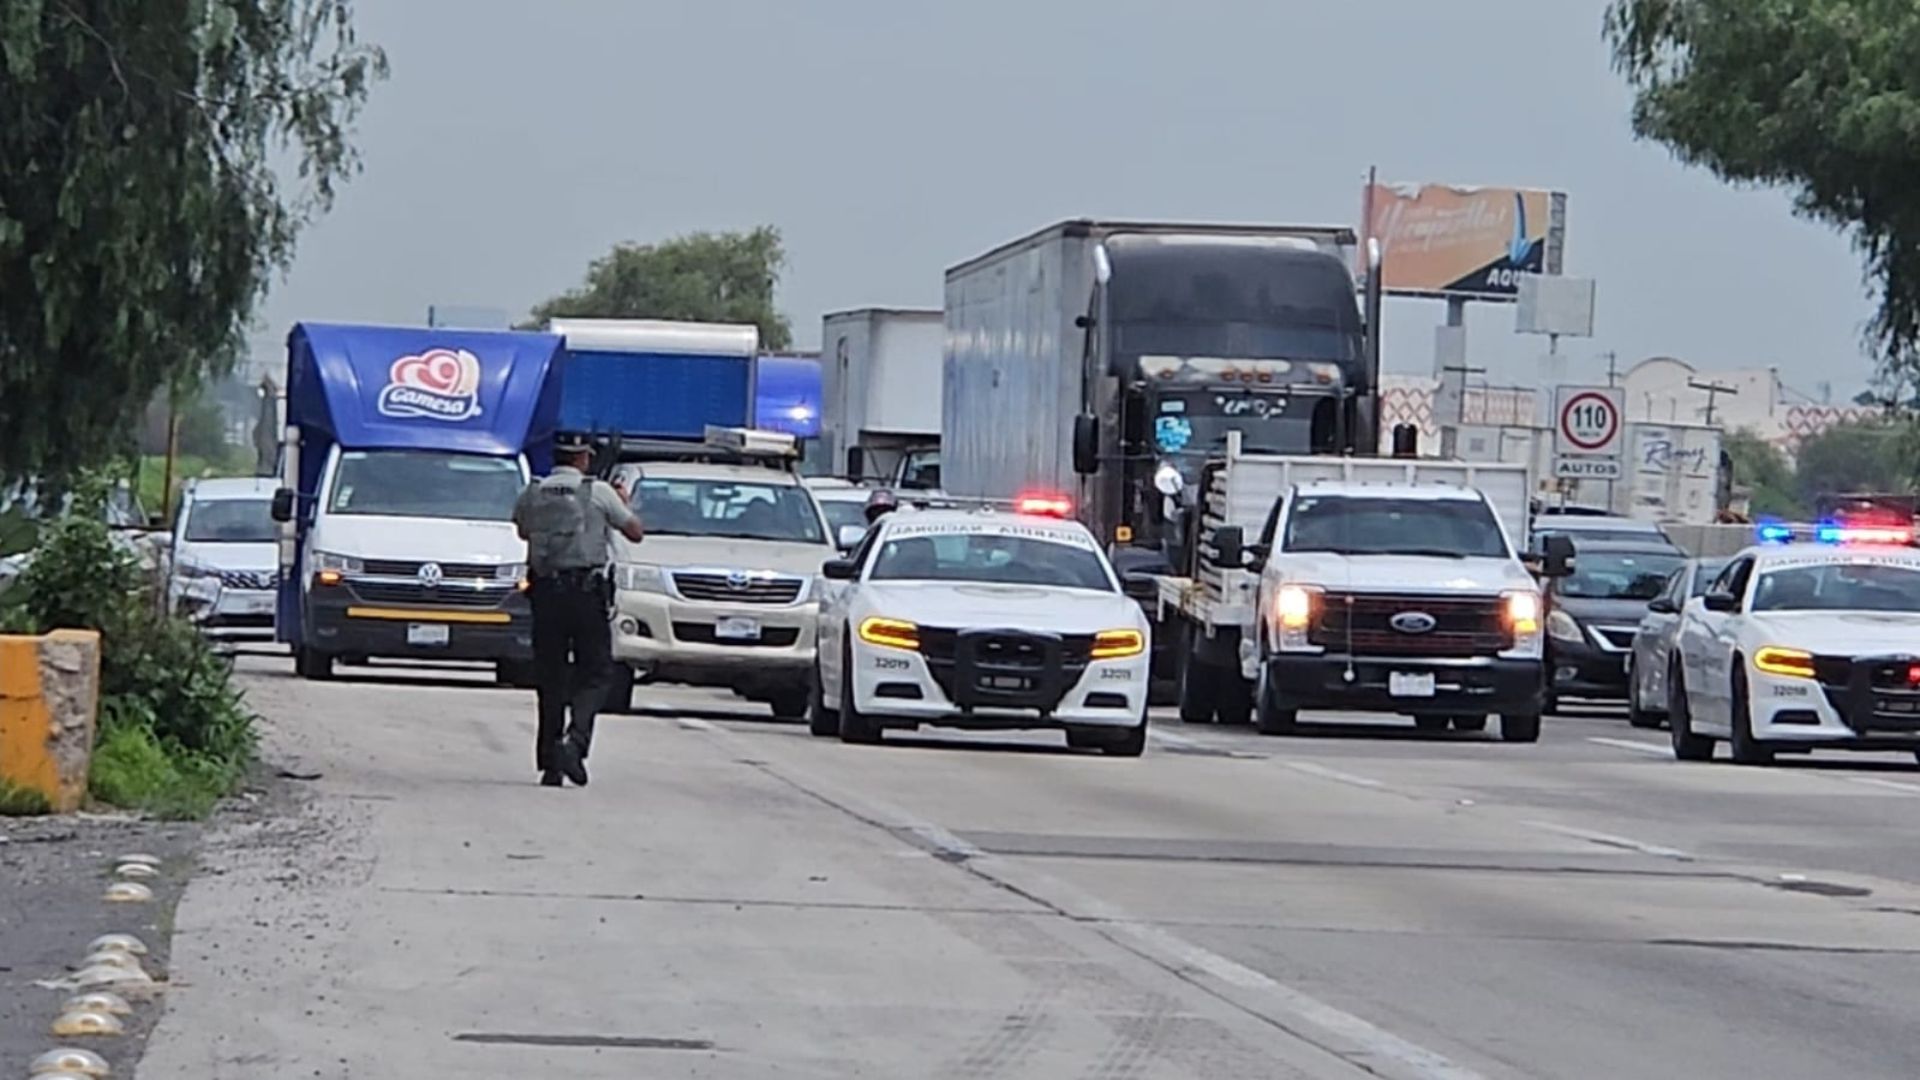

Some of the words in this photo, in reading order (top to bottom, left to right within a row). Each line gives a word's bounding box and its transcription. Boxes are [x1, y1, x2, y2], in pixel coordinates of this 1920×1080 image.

[389, 387, 466, 414] Gamesa
[1573, 404, 1607, 430] 110
[1559, 462, 1618, 476] AUTOS
